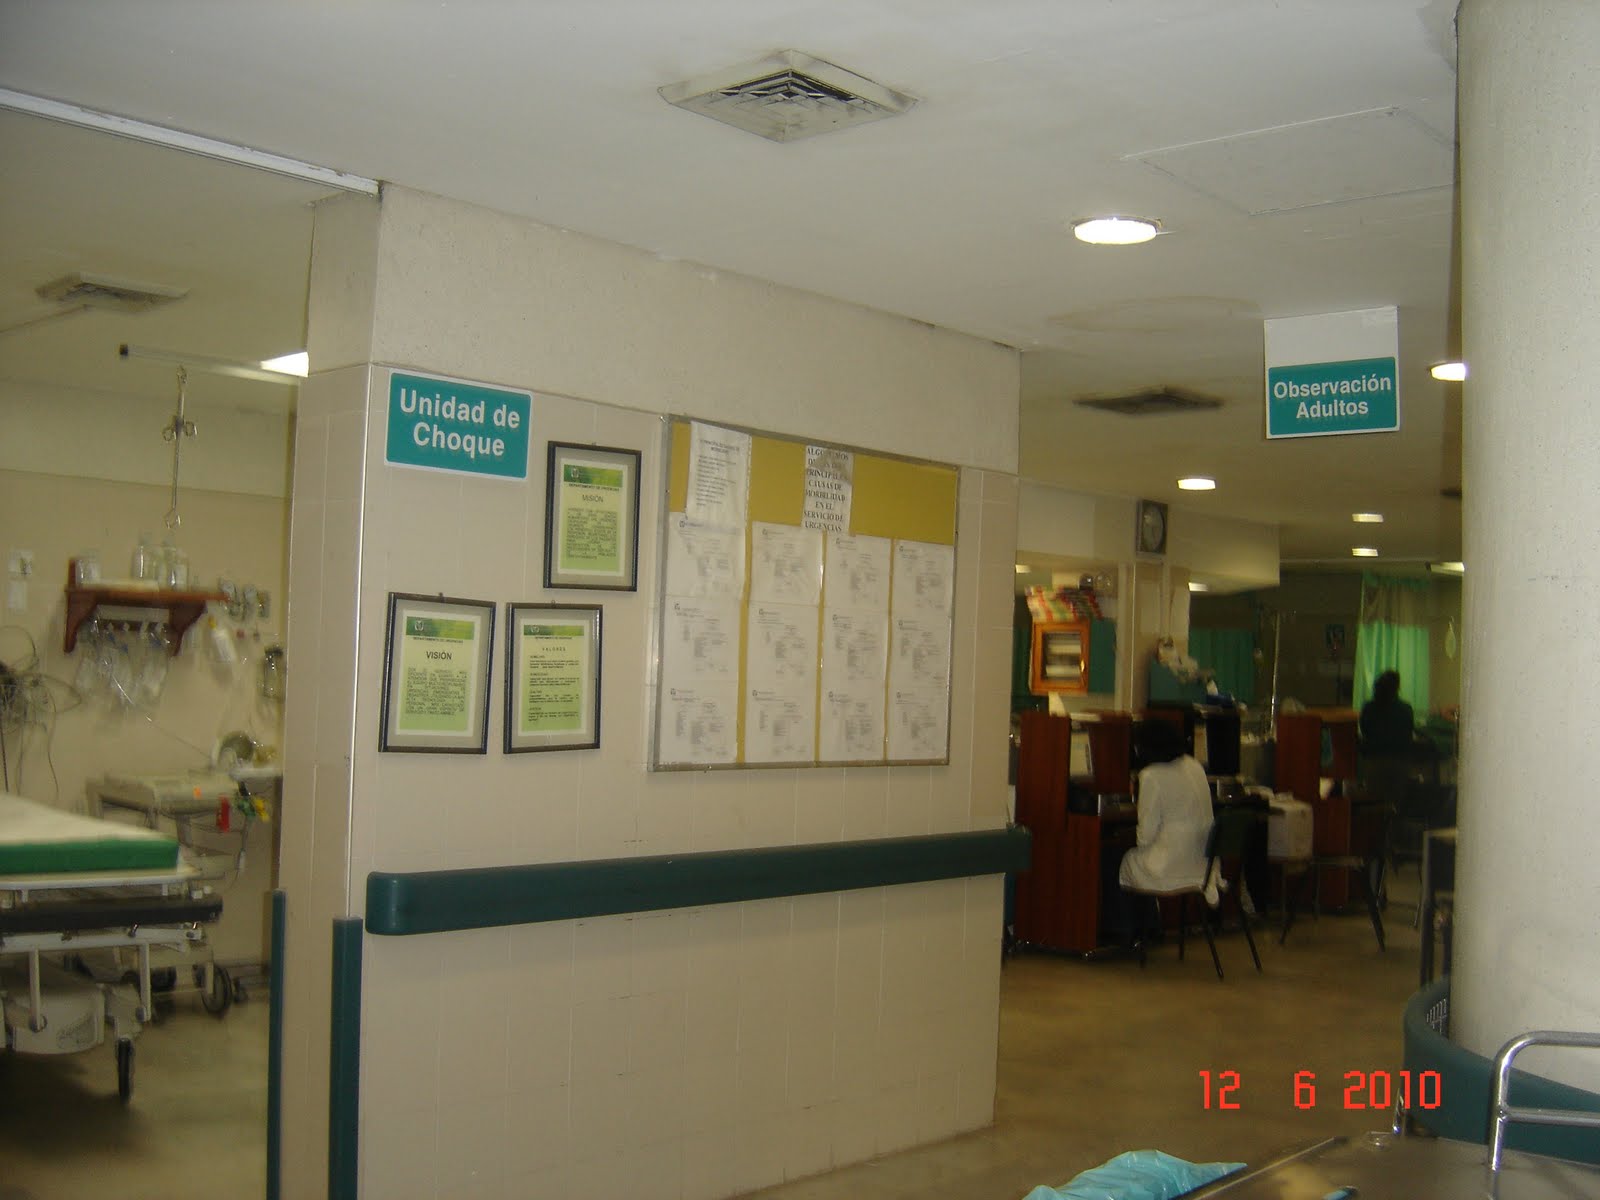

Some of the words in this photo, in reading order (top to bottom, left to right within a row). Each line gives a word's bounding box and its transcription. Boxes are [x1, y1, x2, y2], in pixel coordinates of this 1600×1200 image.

[1273, 373, 1392, 399] Observación
[400, 387, 485, 424] Unidad
[493, 404, 521, 429] de
[1296, 399, 1369, 419] Adultos
[413, 421, 505, 459] Choque
